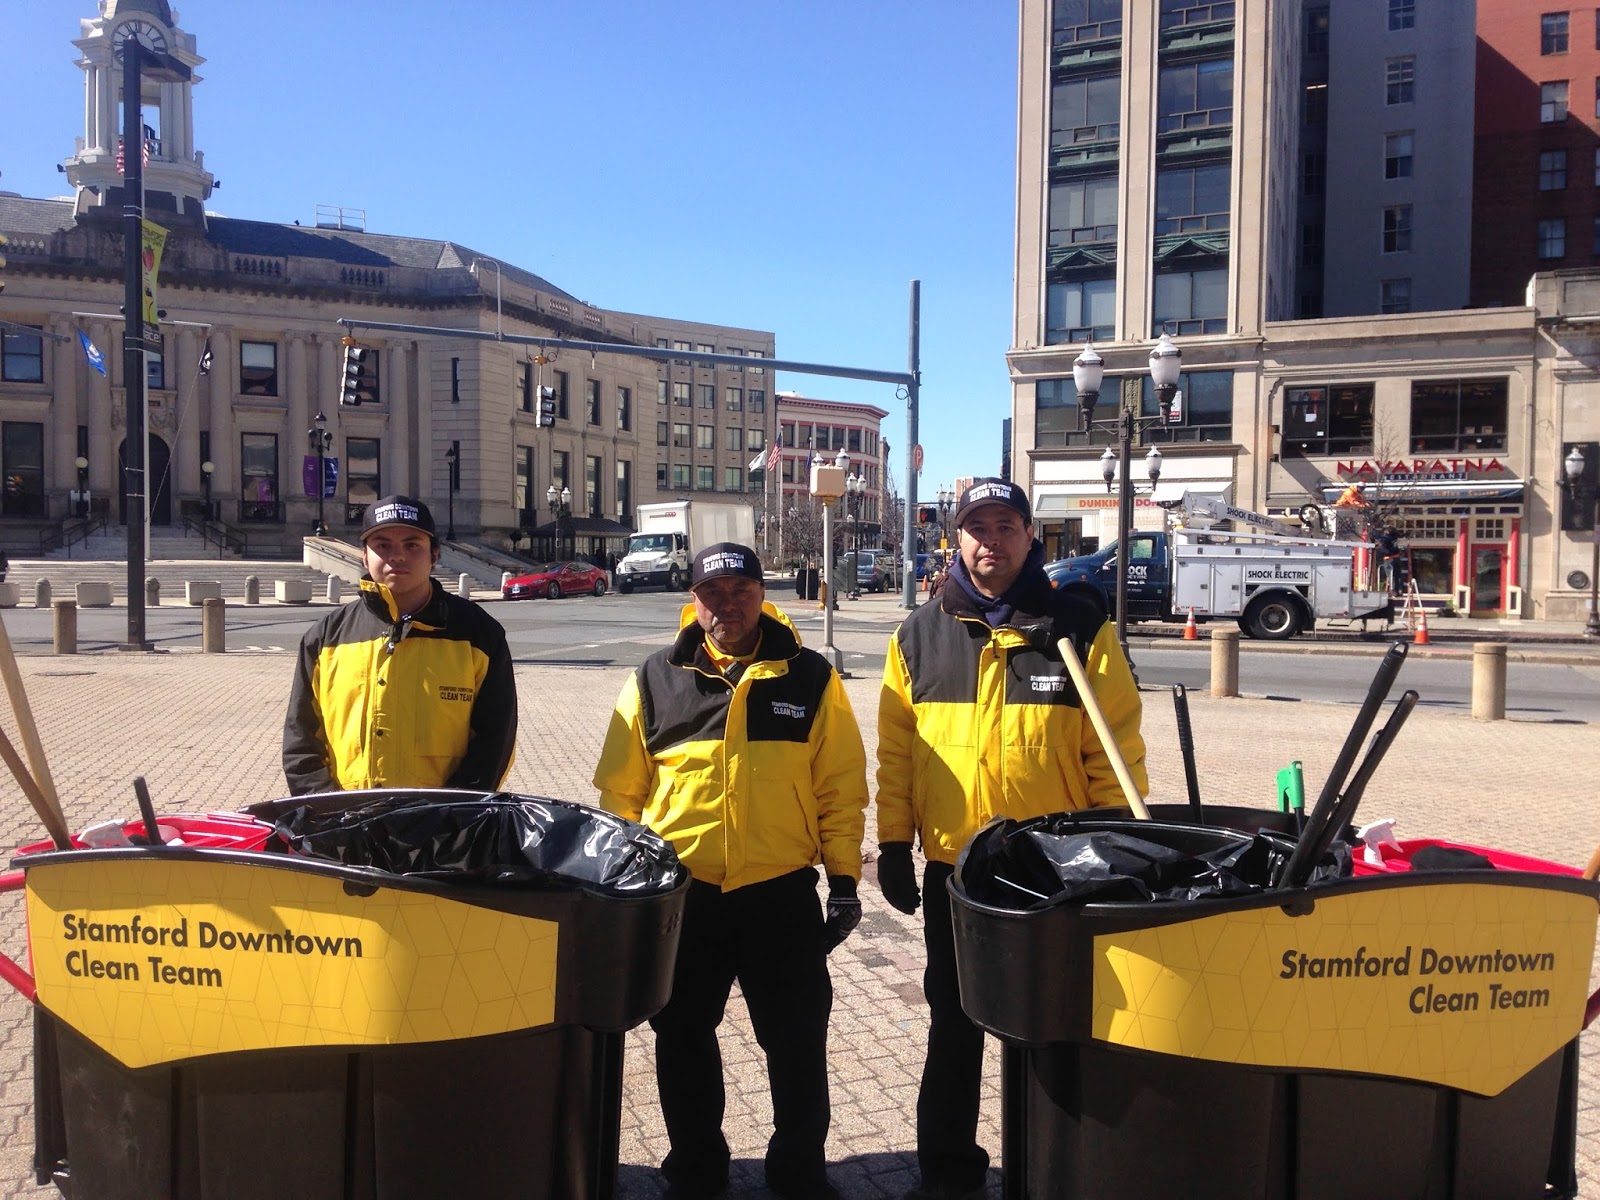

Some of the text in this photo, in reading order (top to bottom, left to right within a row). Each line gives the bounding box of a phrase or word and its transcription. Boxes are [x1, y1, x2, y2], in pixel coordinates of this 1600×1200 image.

[970, 488, 1011, 502] CLEAN TEAM
[375, 509, 418, 522] CLEAN TEAM
[1226, 507, 1274, 527] SHOCK ELECTRIC
[703, 558, 744, 573] CLEAN TEAM
[1128, 565, 1147, 576] OCK
[1248, 570, 1309, 579] SHOCK ELECTRIC
[1031, 682, 1051, 691] CLEAN
[440, 692, 459, 701] CLEAN
[773, 706, 805, 719] CLEAN TEAM
[63, 913, 363, 958] Stamford Downtown
[65, 949, 222, 988] Clean Team
[1280, 946, 1555, 979] Stamford Downtown
[1409, 983, 1550, 1014] Clean Team
